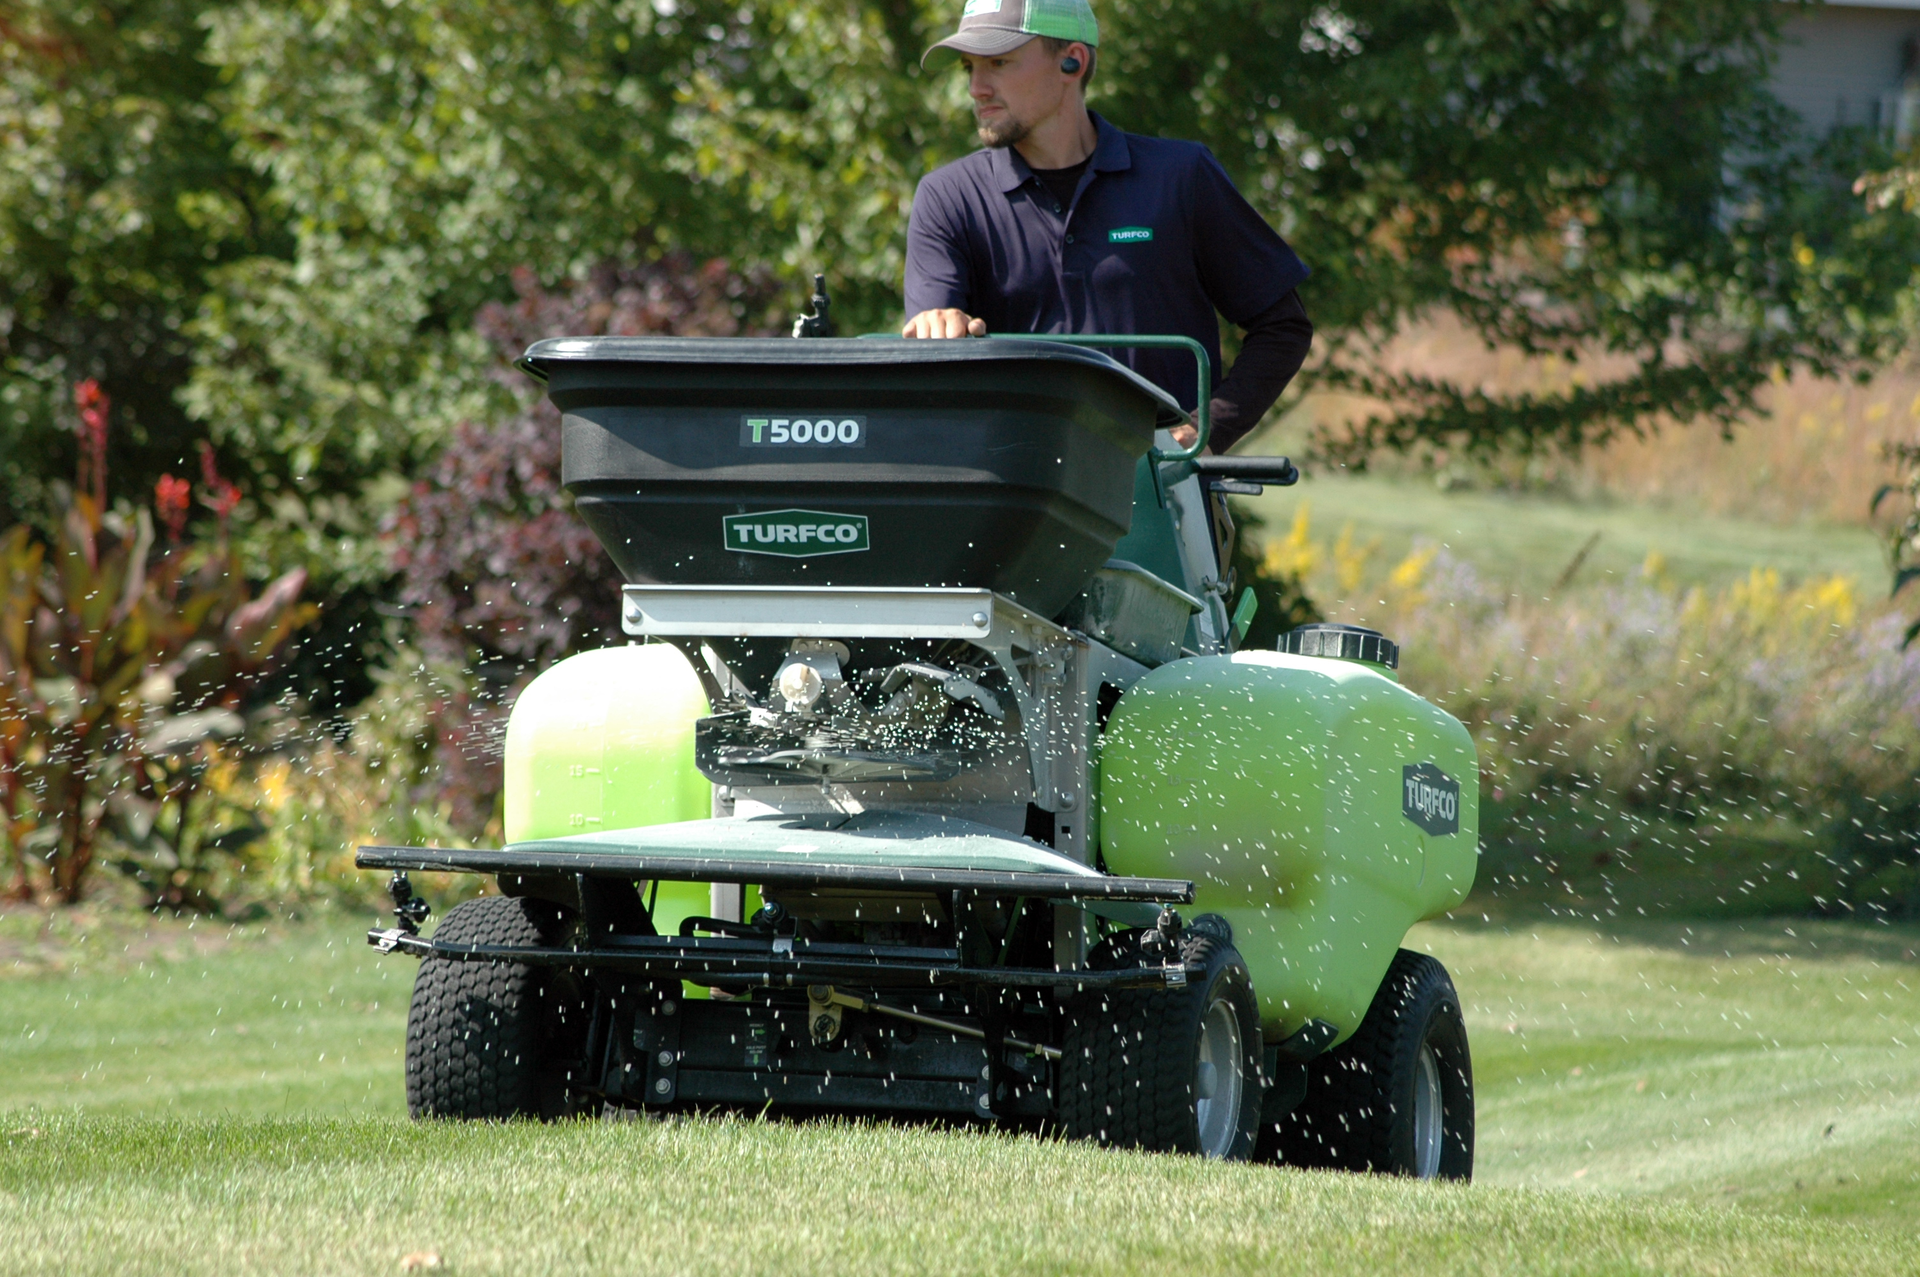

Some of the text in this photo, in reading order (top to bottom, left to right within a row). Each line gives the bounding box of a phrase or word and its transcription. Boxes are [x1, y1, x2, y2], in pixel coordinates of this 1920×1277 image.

[1111, 230, 1150, 240] TURFCO
[747, 419, 860, 443] T5000
[569, 764, 583, 777] 15
[1405, 778, 1456, 822] TURFCO
[569, 812, 584, 826] 10
